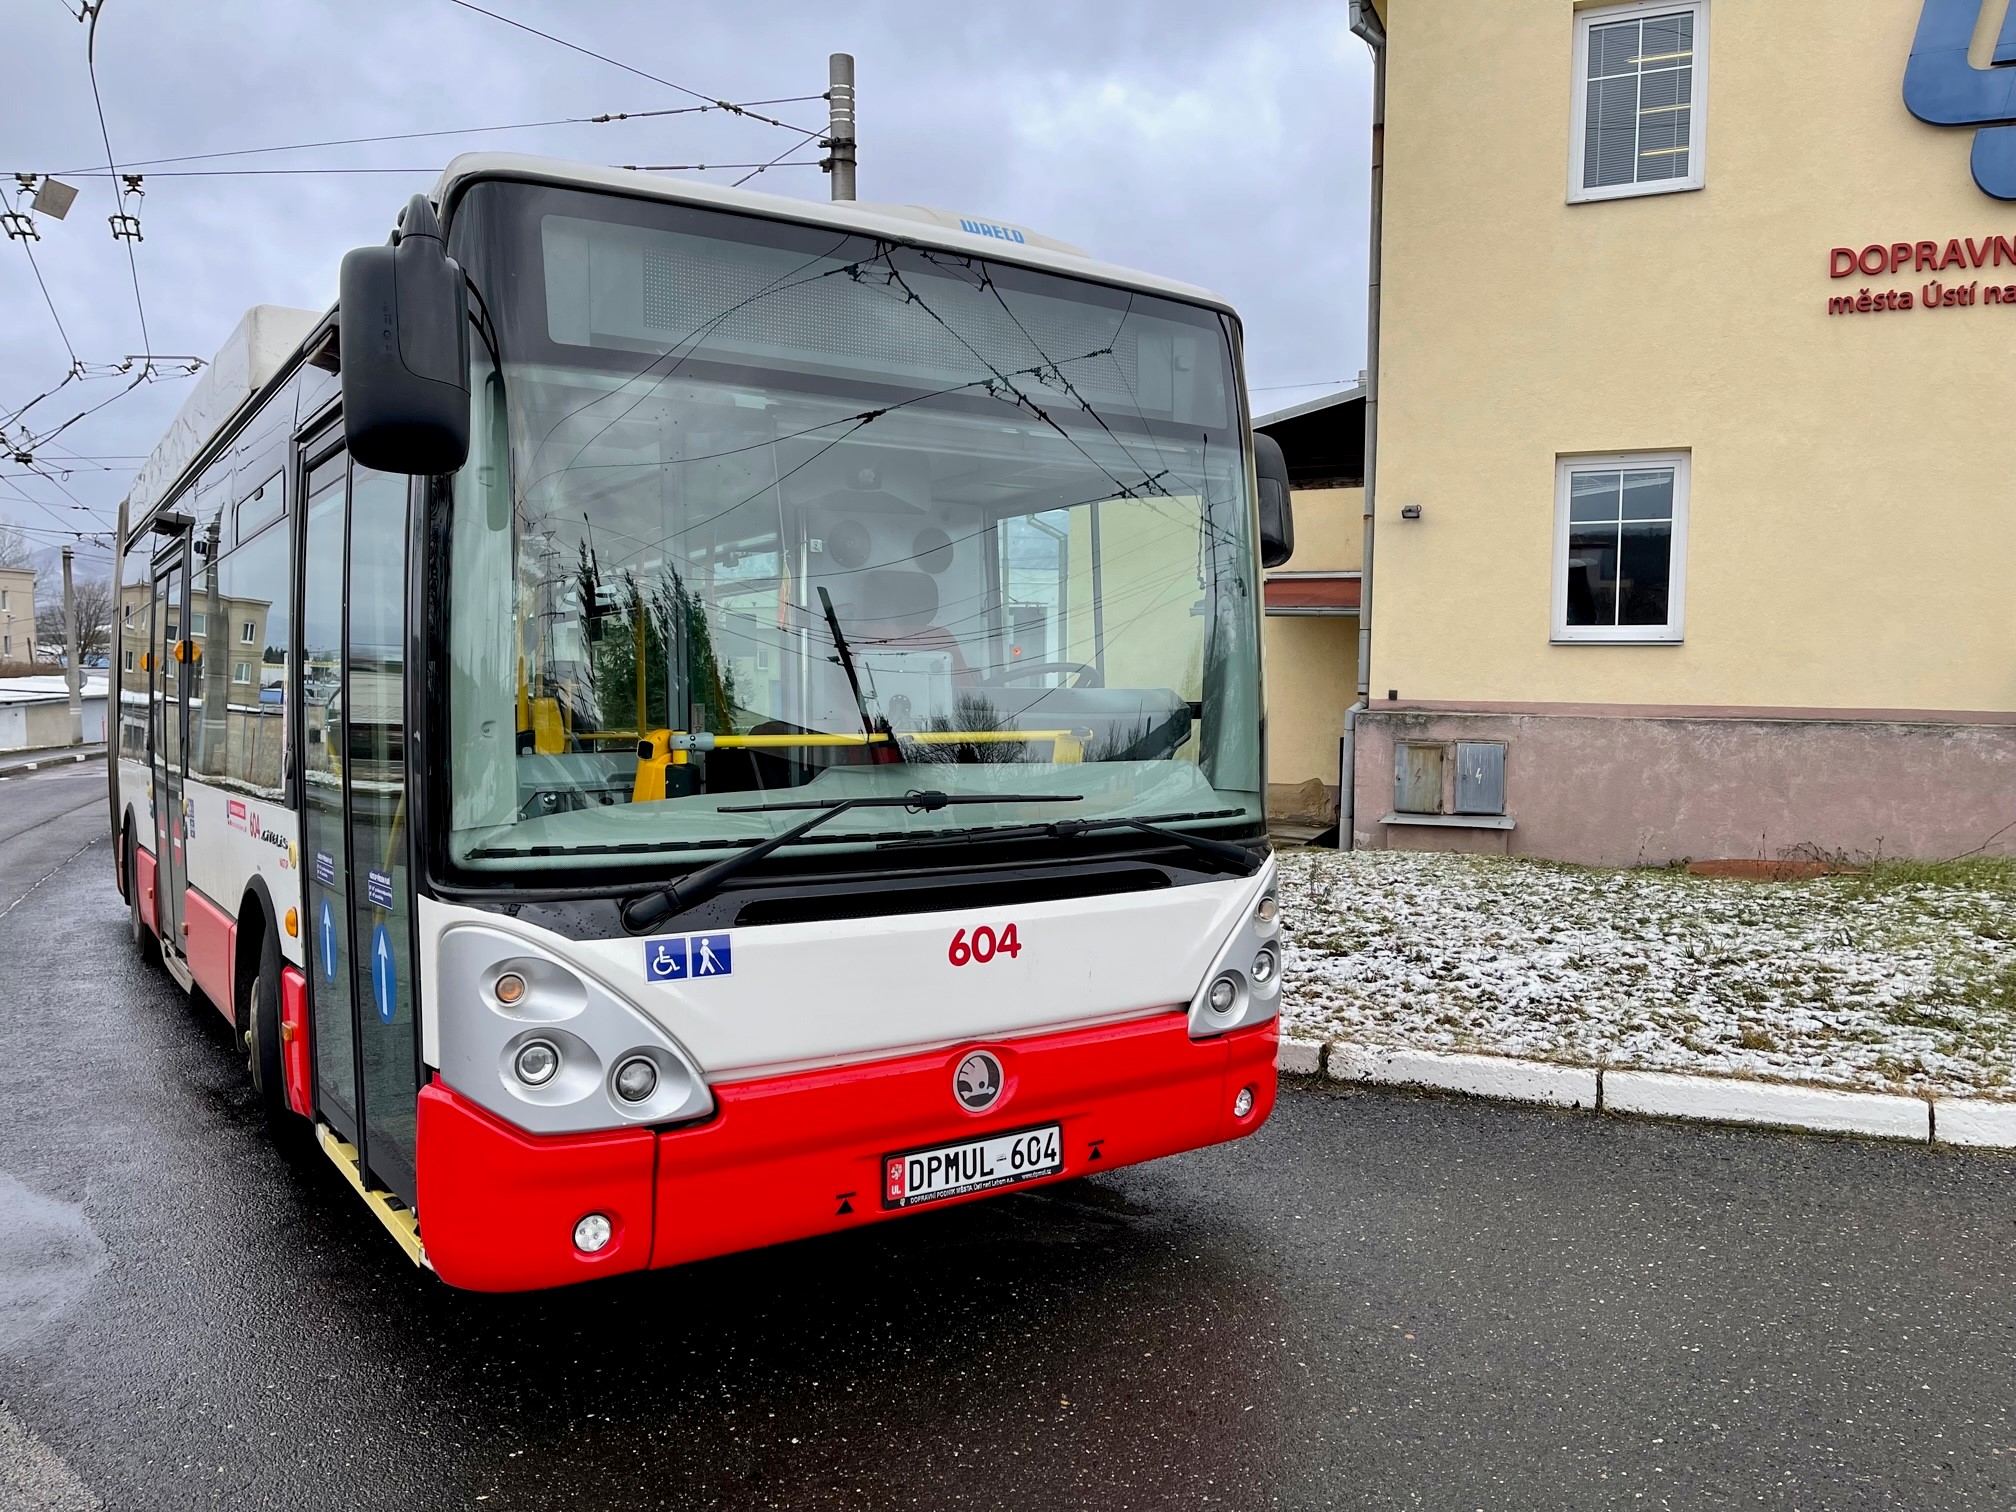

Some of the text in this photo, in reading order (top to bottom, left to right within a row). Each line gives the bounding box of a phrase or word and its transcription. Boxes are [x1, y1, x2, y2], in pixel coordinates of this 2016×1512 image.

[1830, 236, 2016, 278] DOPRAVN
[1828, 288, 1914, 315] města
[1922, 280, 1978, 308] Ústí
[249, 811, 261, 840] 604
[948, 923, 1022, 967] 604
[891, 1185, 902, 1195] UL
